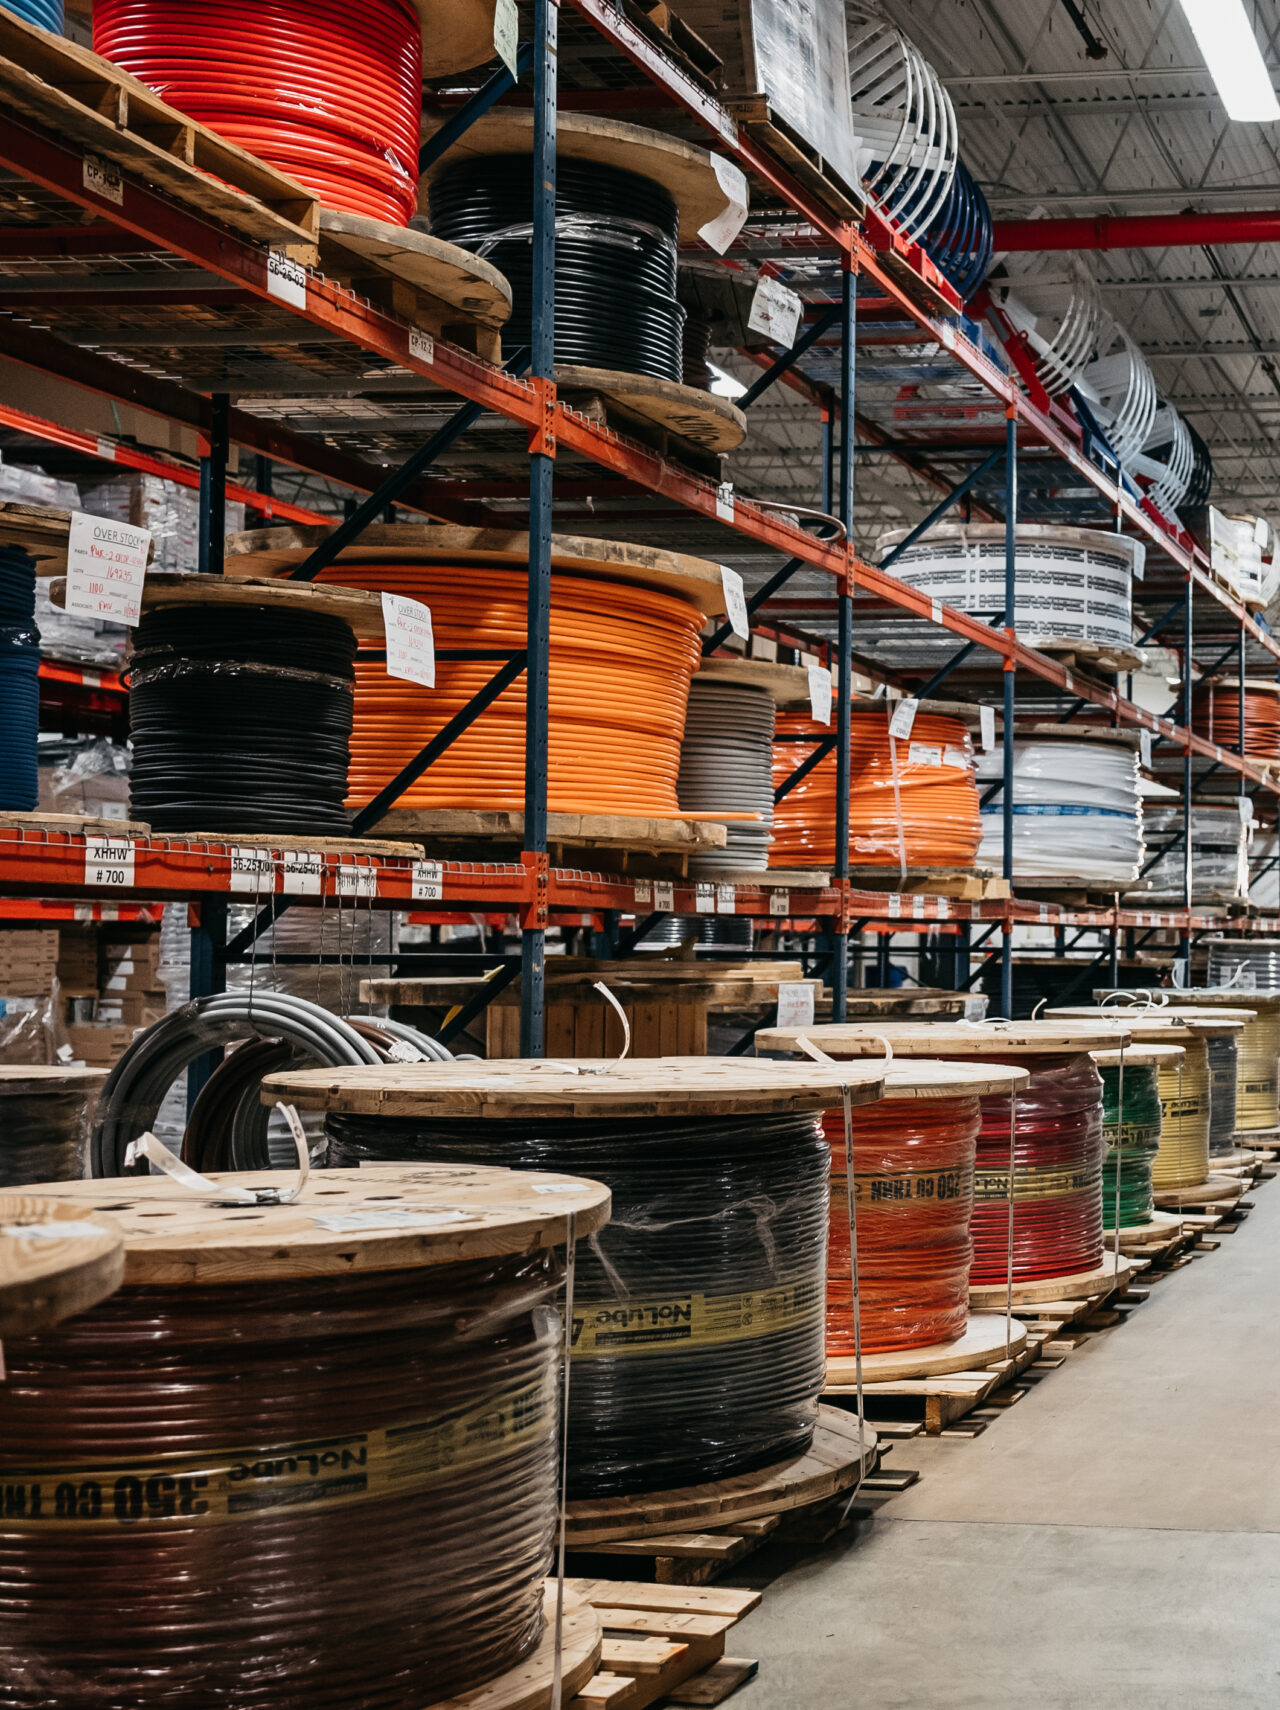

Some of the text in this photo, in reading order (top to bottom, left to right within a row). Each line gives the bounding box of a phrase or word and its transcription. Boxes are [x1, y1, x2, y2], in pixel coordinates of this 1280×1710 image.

[93, 526, 118, 541] OVER
[94, 847, 128, 860] XHHW
[106, 870, 125, 884] 700
[916, 1177, 935, 1199] CU
[595, 1303, 691, 1328] NoLube
[227, 1446, 368, 1482] NoLube
[0, 1482, 42, 1519] TH
[55, 1481, 102, 1518] CU
[114, 1471, 209, 1525] 350
